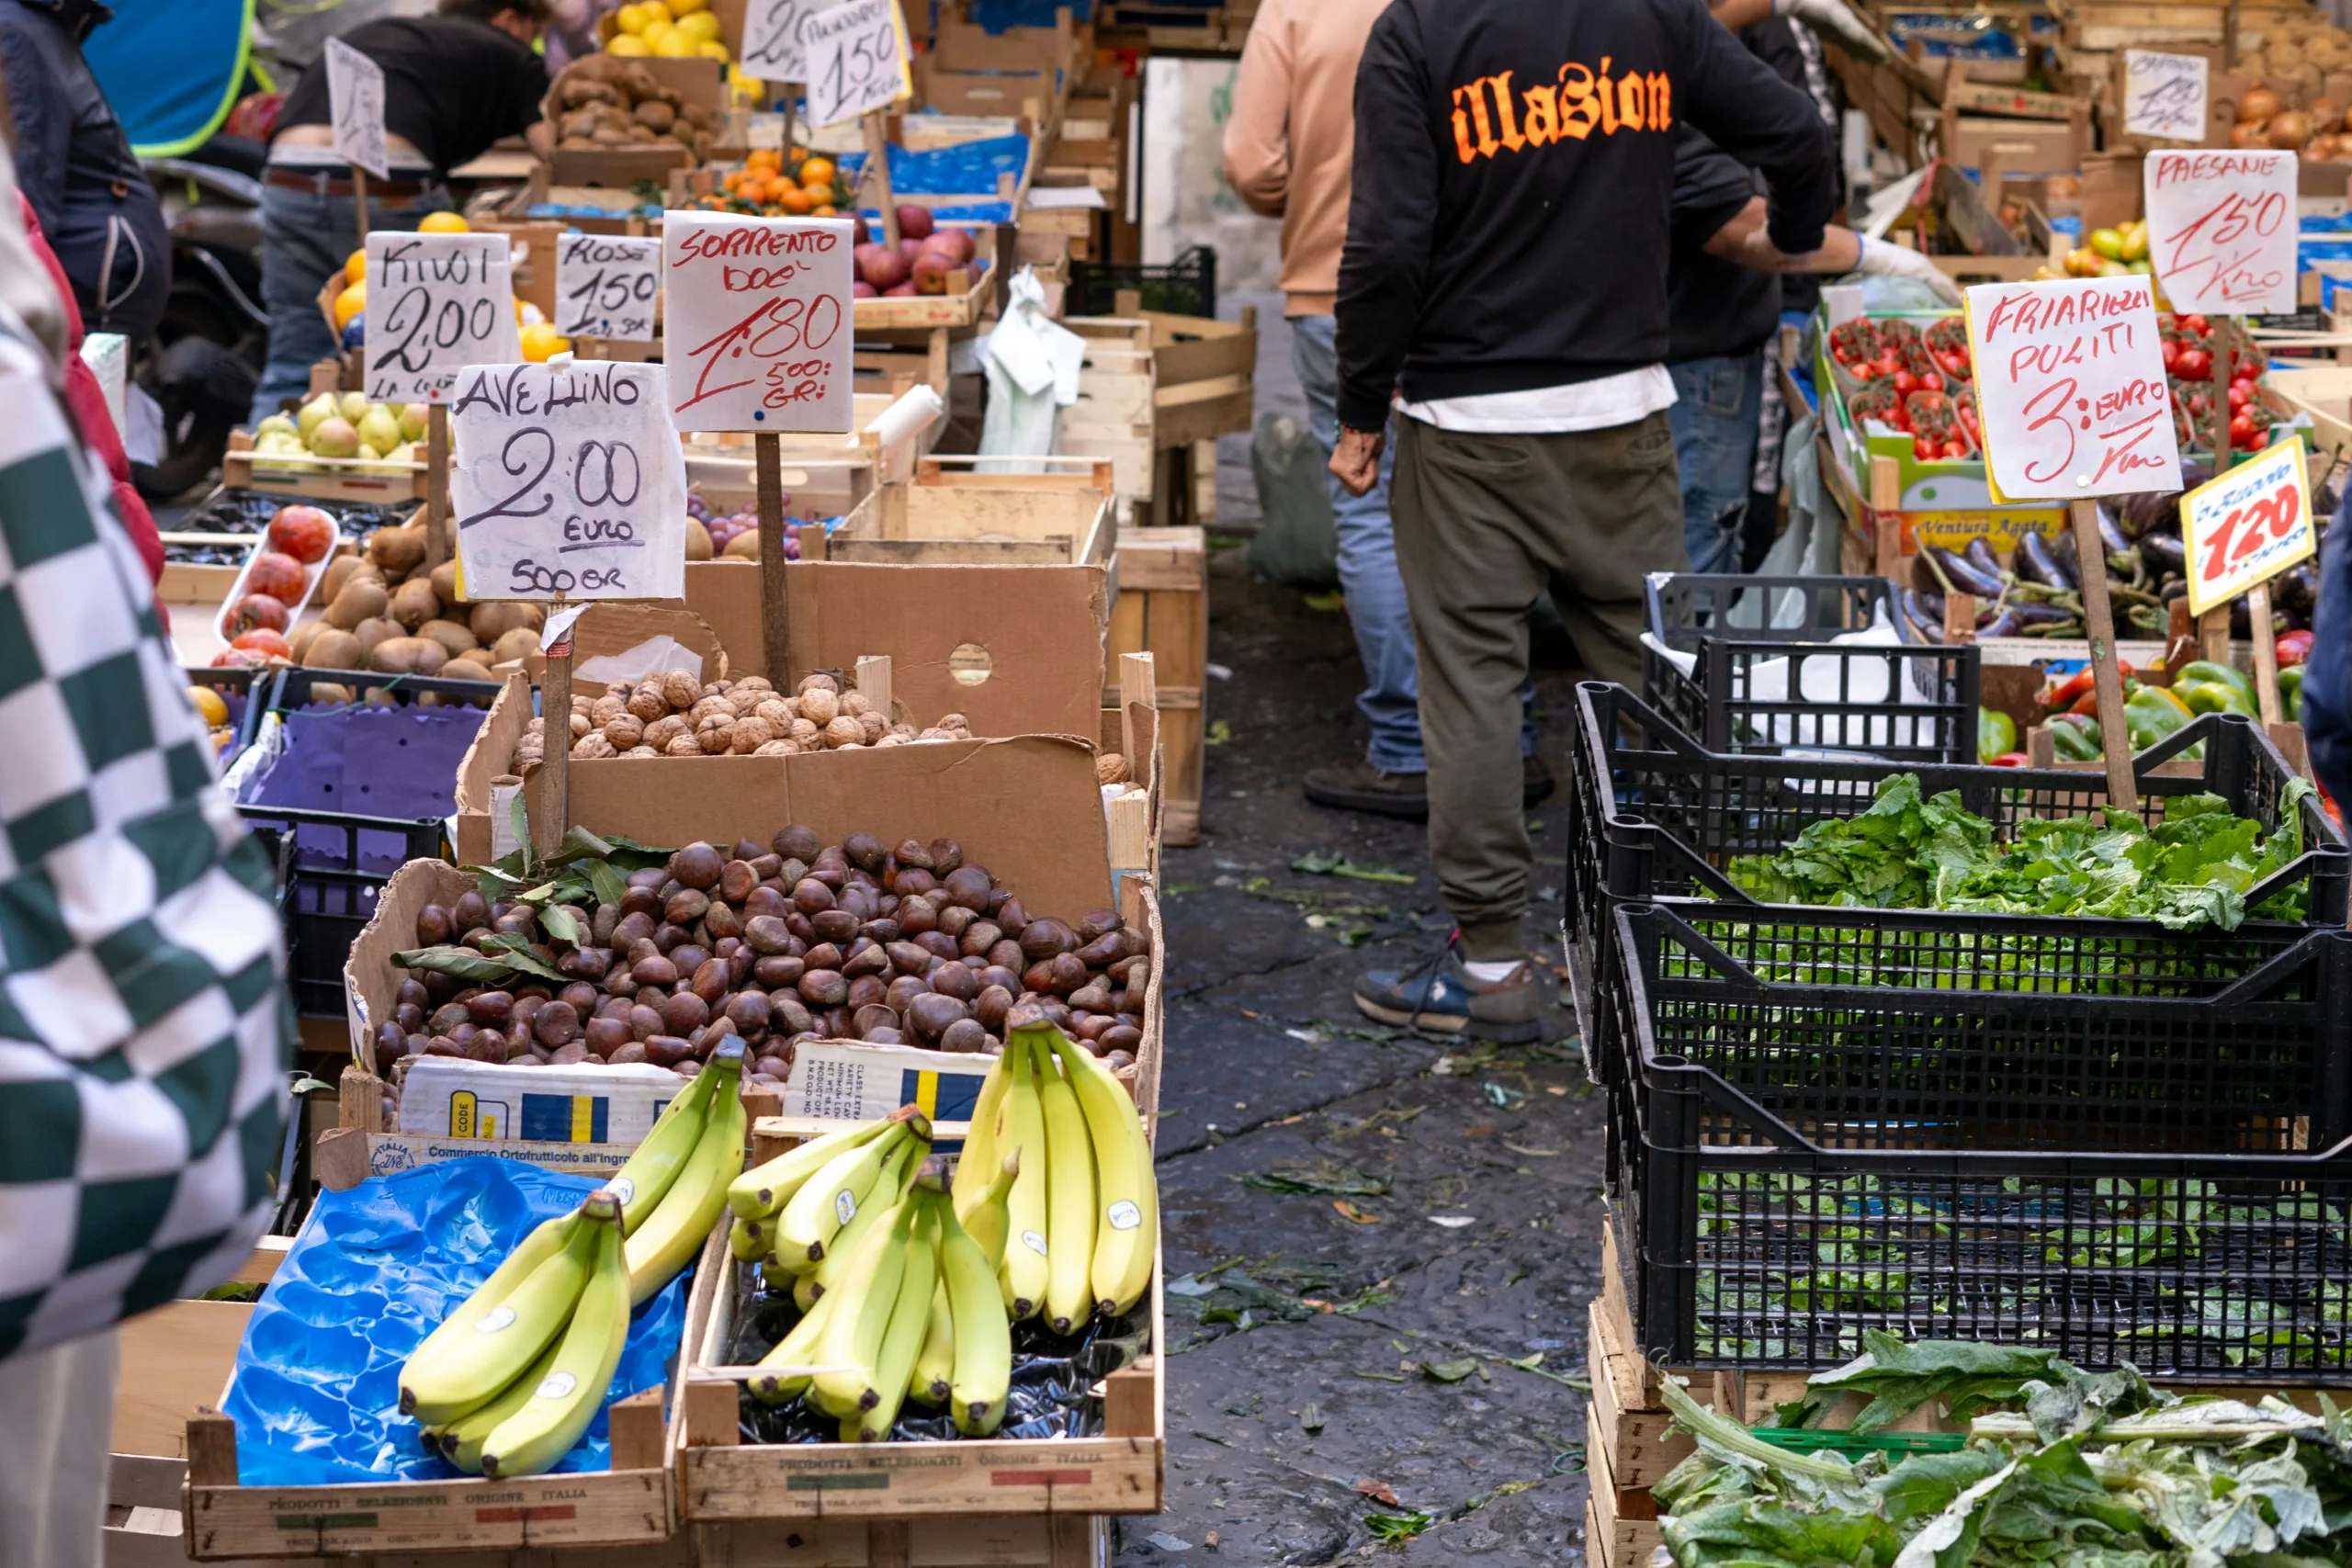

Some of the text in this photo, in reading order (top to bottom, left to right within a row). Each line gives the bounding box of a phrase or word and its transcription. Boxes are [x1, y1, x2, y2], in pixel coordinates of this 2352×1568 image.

[2155, 153, 2281, 189] PAESANE
[381, 240, 487, 288] KIWI
[2009, 321, 2134, 383] PULITI
[453, 364, 639, 417] AVELLINO
[2097, 378, 2165, 421] EURO
[563, 515, 634, 541] EURO
[1921, 518, 1990, 535] Ventura
[815, 1060, 825, 1099] PRODUCT
[827, 1062, 835, 1077] NET
[833, 1062, 844, 1119] MINIMUM LEN
[458, 1102, 469, 1132] CODE
[814, 1100, 821, 1112] OF
[843, 1101, 852, 1120] CAV
[377, 1143, 409, 1155] ITALIA
[428, 1145, 497, 1159] Commercio
[500, 1148, 580, 1163] Ortofrutticolo
[778, 1458, 852, 1470] PRODOTTI
[979, 1453, 1040, 1466] ORIGINE
[1057, 1452, 1103, 1464] ITALIA
[268, 1496, 341, 1510] PRODOTTI
[465, 1492, 525, 1505] ORIGINE
[541, 1488, 587, 1501] ITALIA
